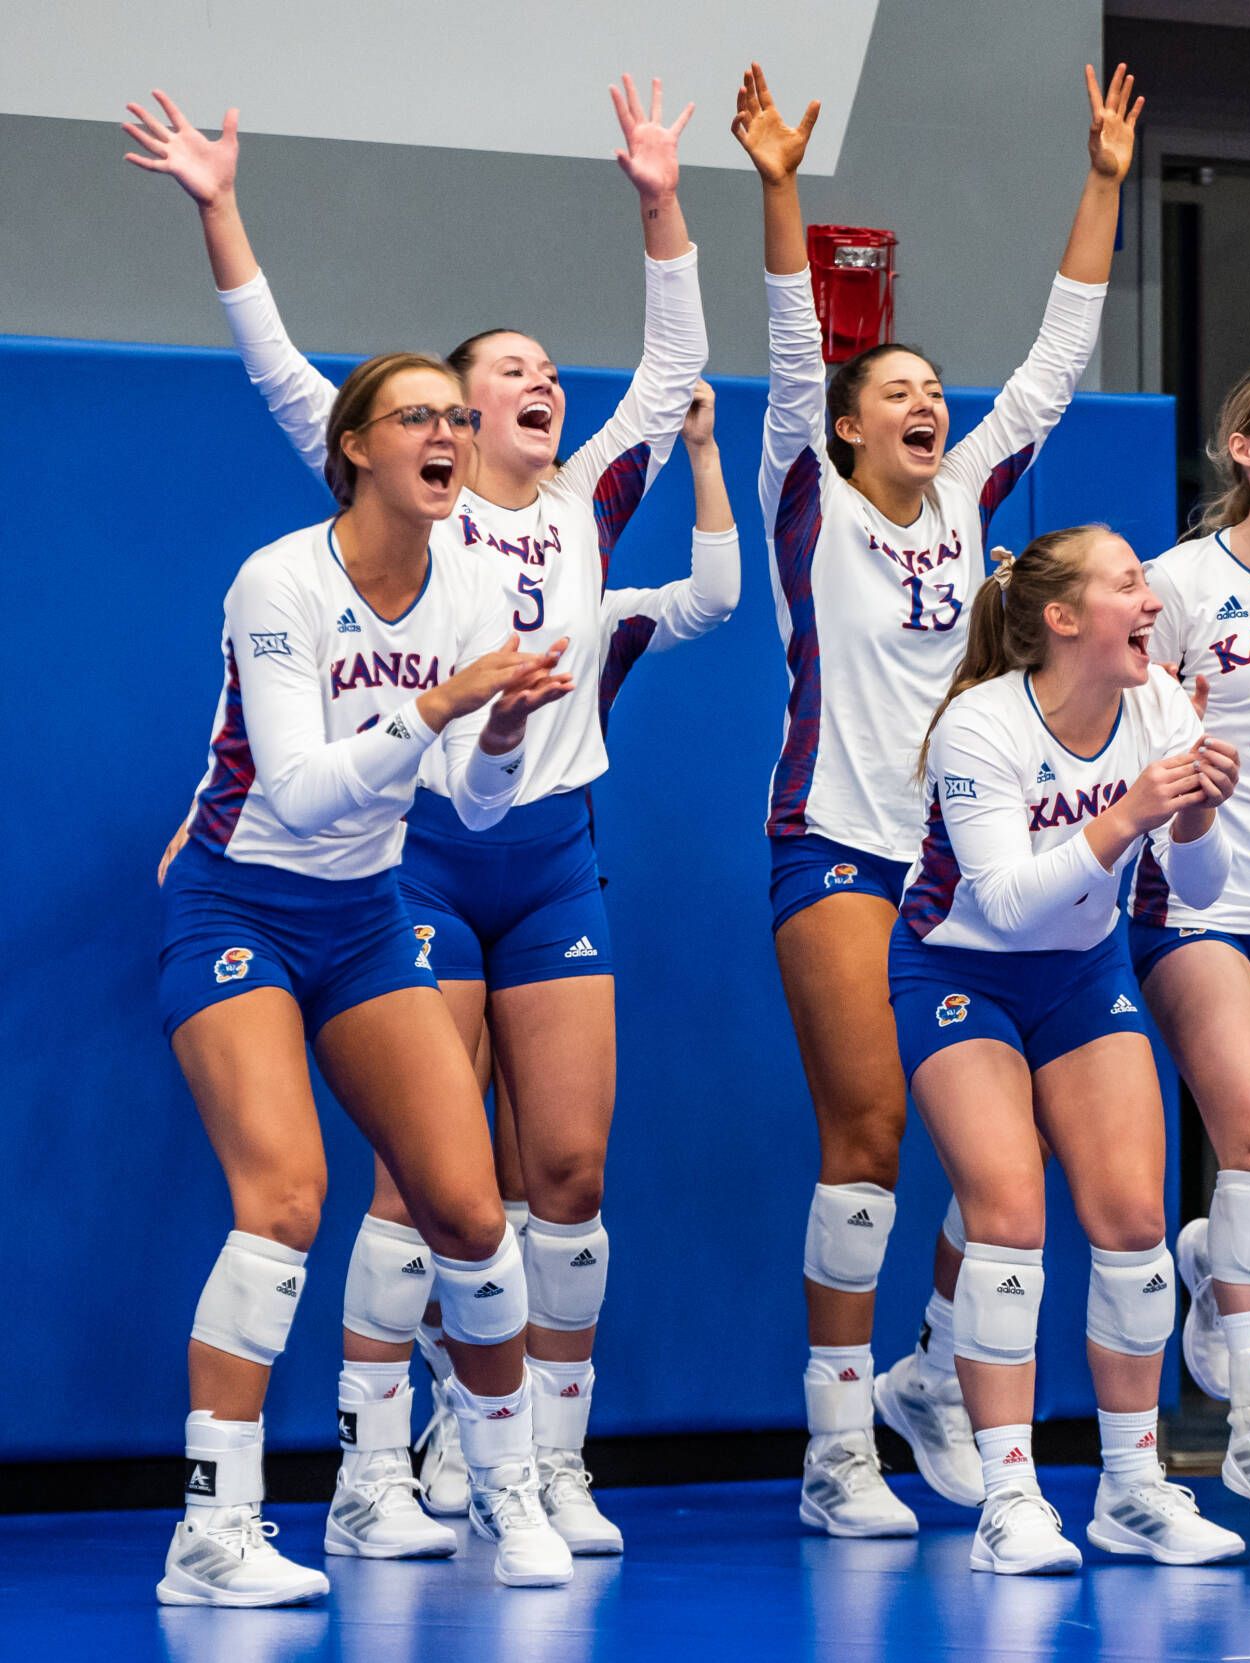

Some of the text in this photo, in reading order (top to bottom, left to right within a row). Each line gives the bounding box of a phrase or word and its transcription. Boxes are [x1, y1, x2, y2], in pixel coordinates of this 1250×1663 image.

[513, 572, 544, 632] 5
[902, 576, 963, 631] 13
[1216, 610, 1249, 620] adidas
[330, 650, 455, 700] KANSA
[564, 948, 598, 958] adidas
[996, 1286, 1025, 1295] adidas
[1142, 1283, 1167, 1293] adidas
